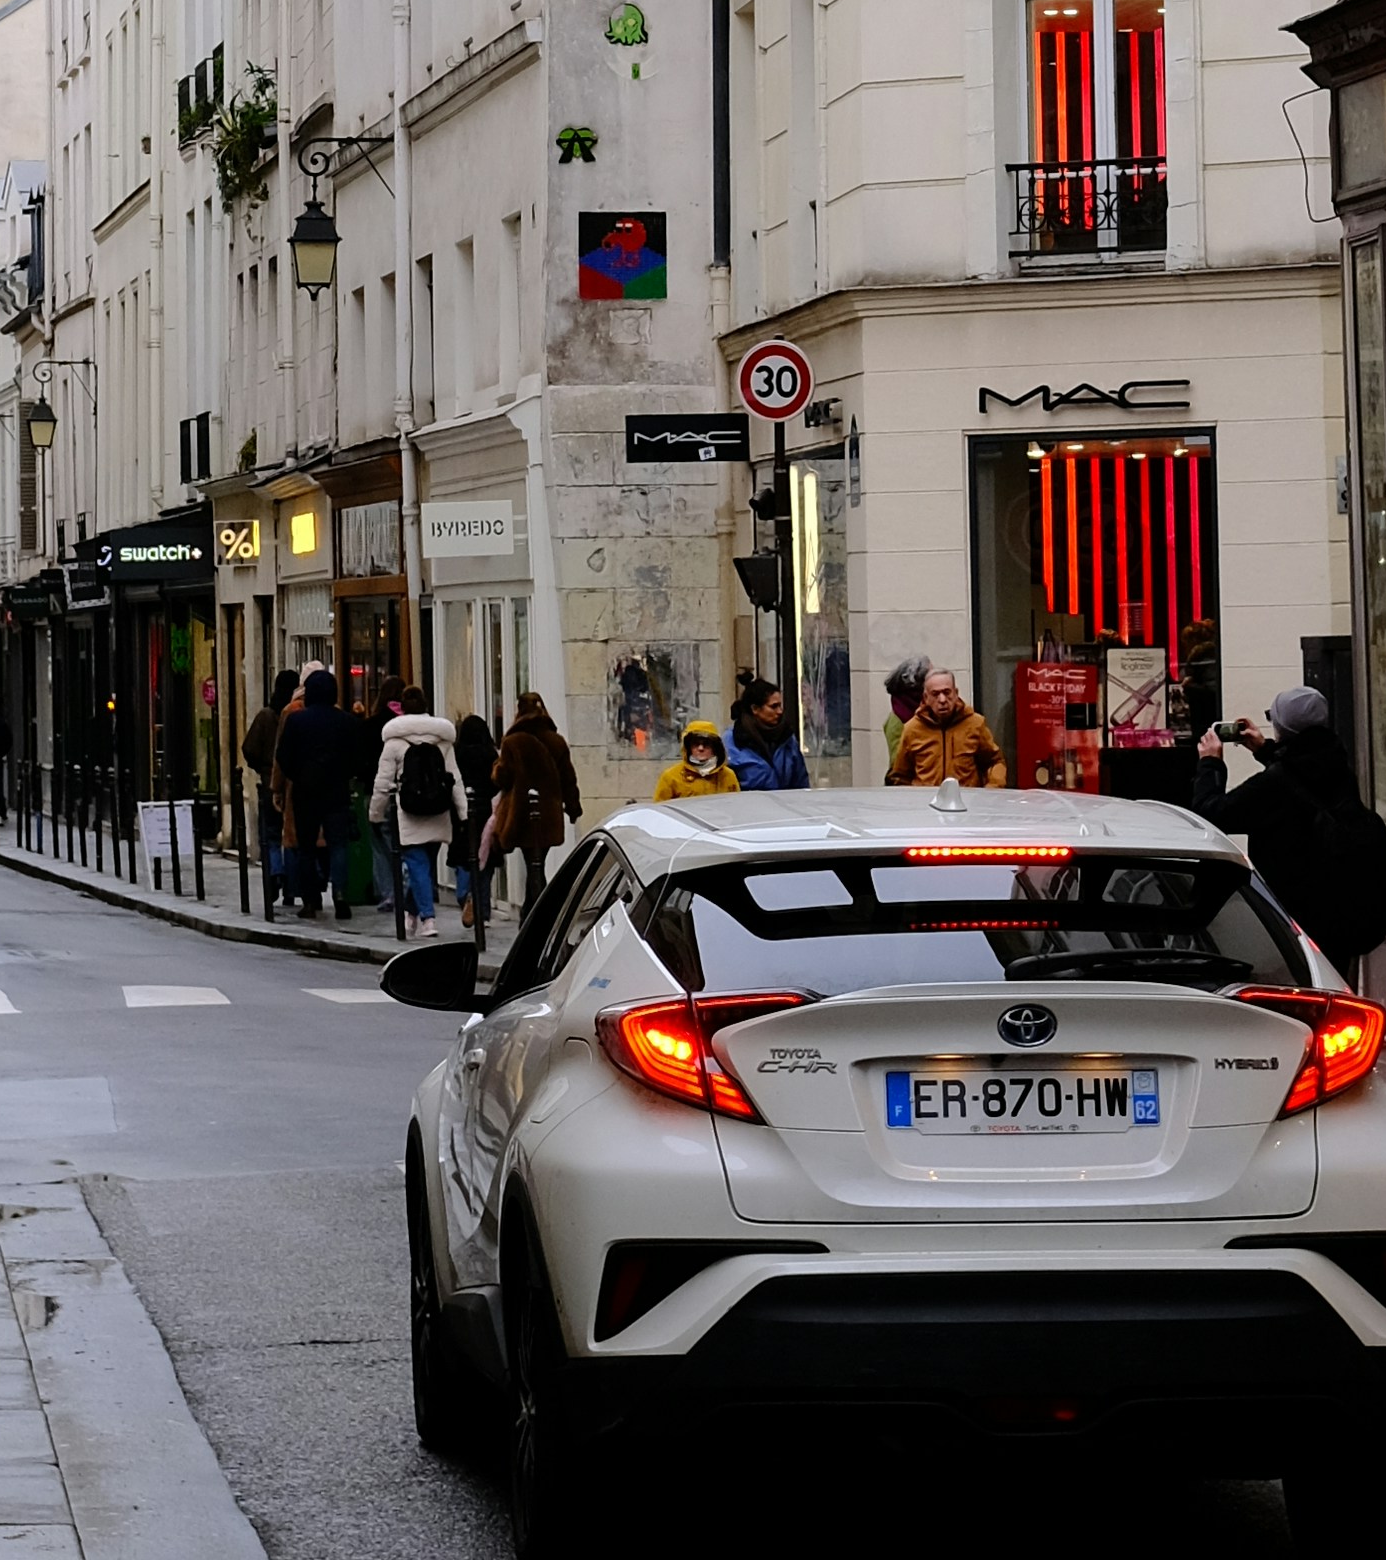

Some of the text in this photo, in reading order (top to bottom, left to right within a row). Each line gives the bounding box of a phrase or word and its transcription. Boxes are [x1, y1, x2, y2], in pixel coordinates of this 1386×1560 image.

[754, 365, 799, 398] 30
[431, 519, 505, 538] BYREDO
[119, 544, 191, 562] swatch
[12, 596, 48, 605] GRANADO
[1028, 682, 1055, 692] BLACK
[770, 1048, 822, 1059] TOYOTA
[757, 1061, 837, 1074] C-HR
[1214, 1058, 1270, 1070] HYBRID
[914, 1077, 1128, 1118] ER-870-HW
[894, 1105, 903, 1117] F
[1135, 1099, 1157, 1119] 62
[986, 1124, 1021, 1132] TOYOTA
